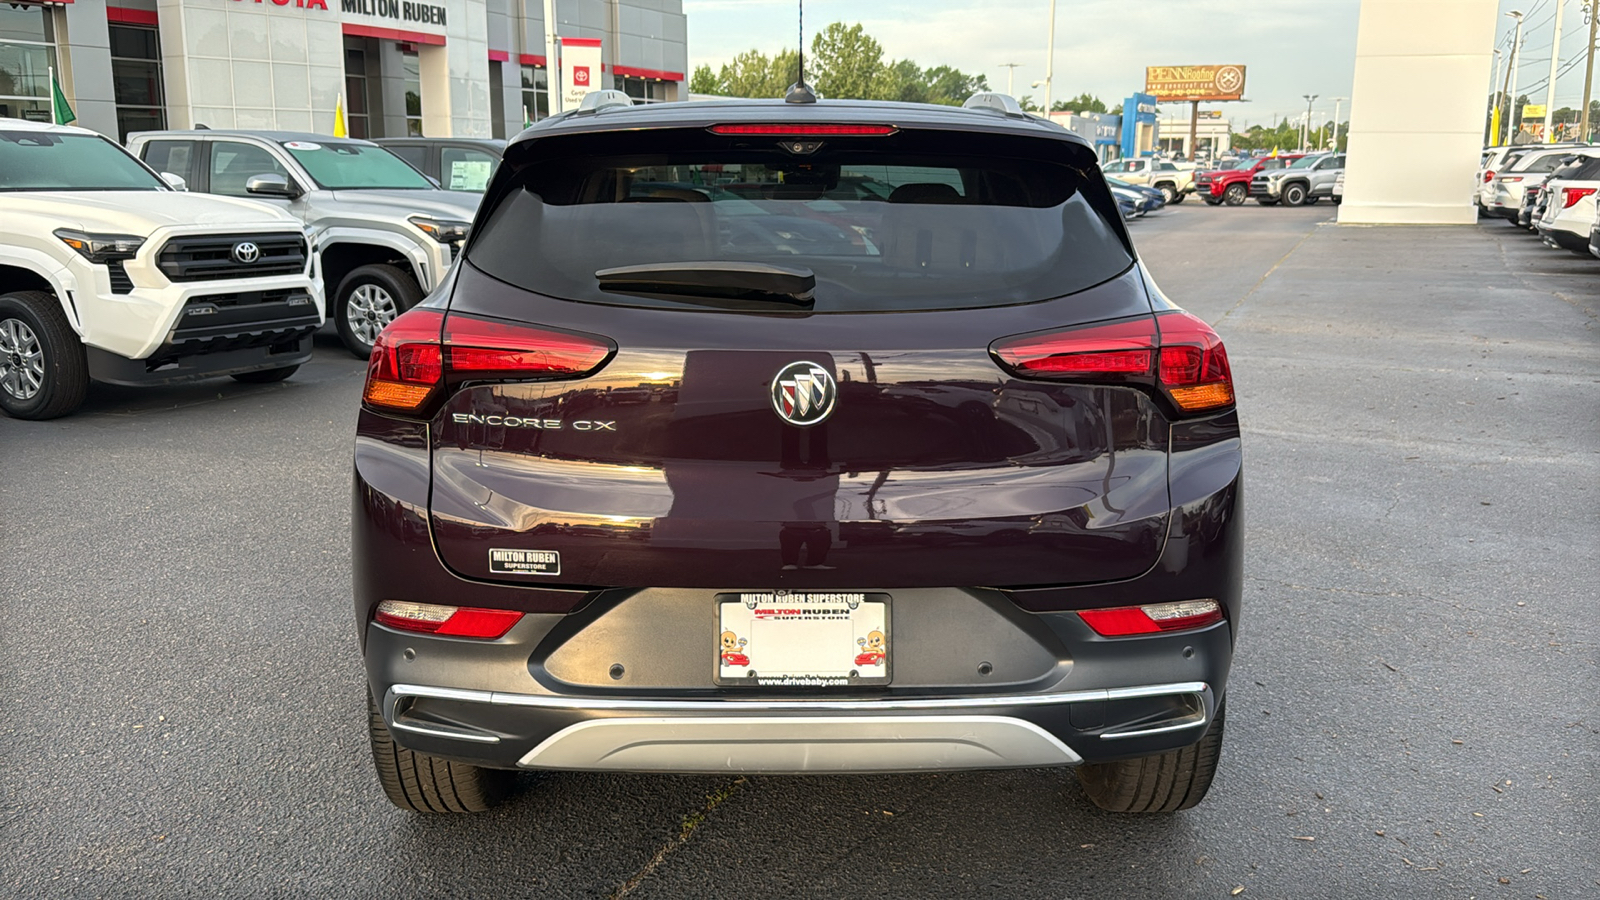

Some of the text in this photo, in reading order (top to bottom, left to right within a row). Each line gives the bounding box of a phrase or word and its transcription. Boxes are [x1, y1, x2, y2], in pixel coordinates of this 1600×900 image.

[341, 0, 400, 19] MILTON
[402, 1, 447, 26] RUBEN
[452, 413, 617, 431] ENCORE GX
[493, 551, 556, 563] MILTON RUBEN
[504, 562, 547, 570] SUPERSTORE
[740, 593, 865, 603] MILTON RUBEN SUPERSTORE
[758, 677, 849, 687] www.drivebaby.com
